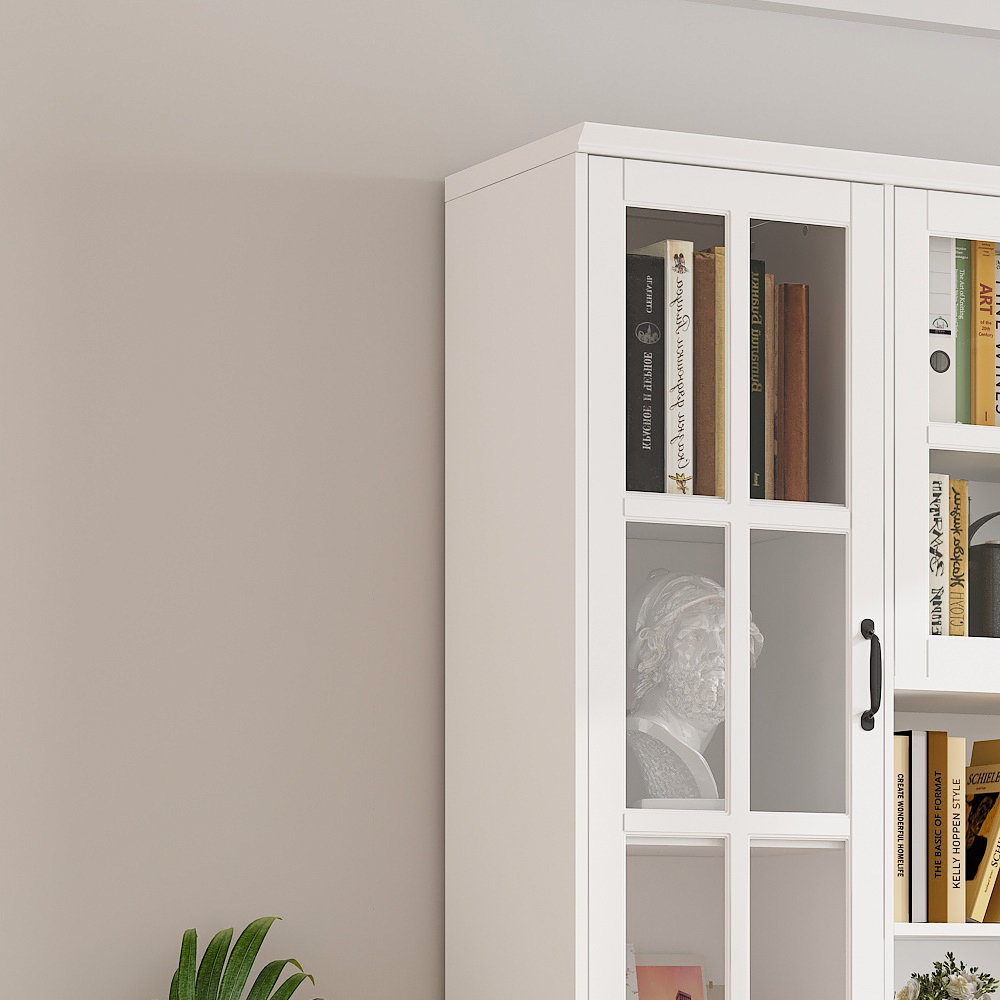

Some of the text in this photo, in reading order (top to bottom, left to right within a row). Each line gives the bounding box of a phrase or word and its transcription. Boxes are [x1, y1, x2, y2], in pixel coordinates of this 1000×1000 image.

[979, 283, 993, 315] ART
[967, 771, 1000, 785] SCHIELE
[934, 771, 942, 878] THE BASIC OF FORMAT
[952, 778, 961, 889] KELLY HOPPEN STYLE
